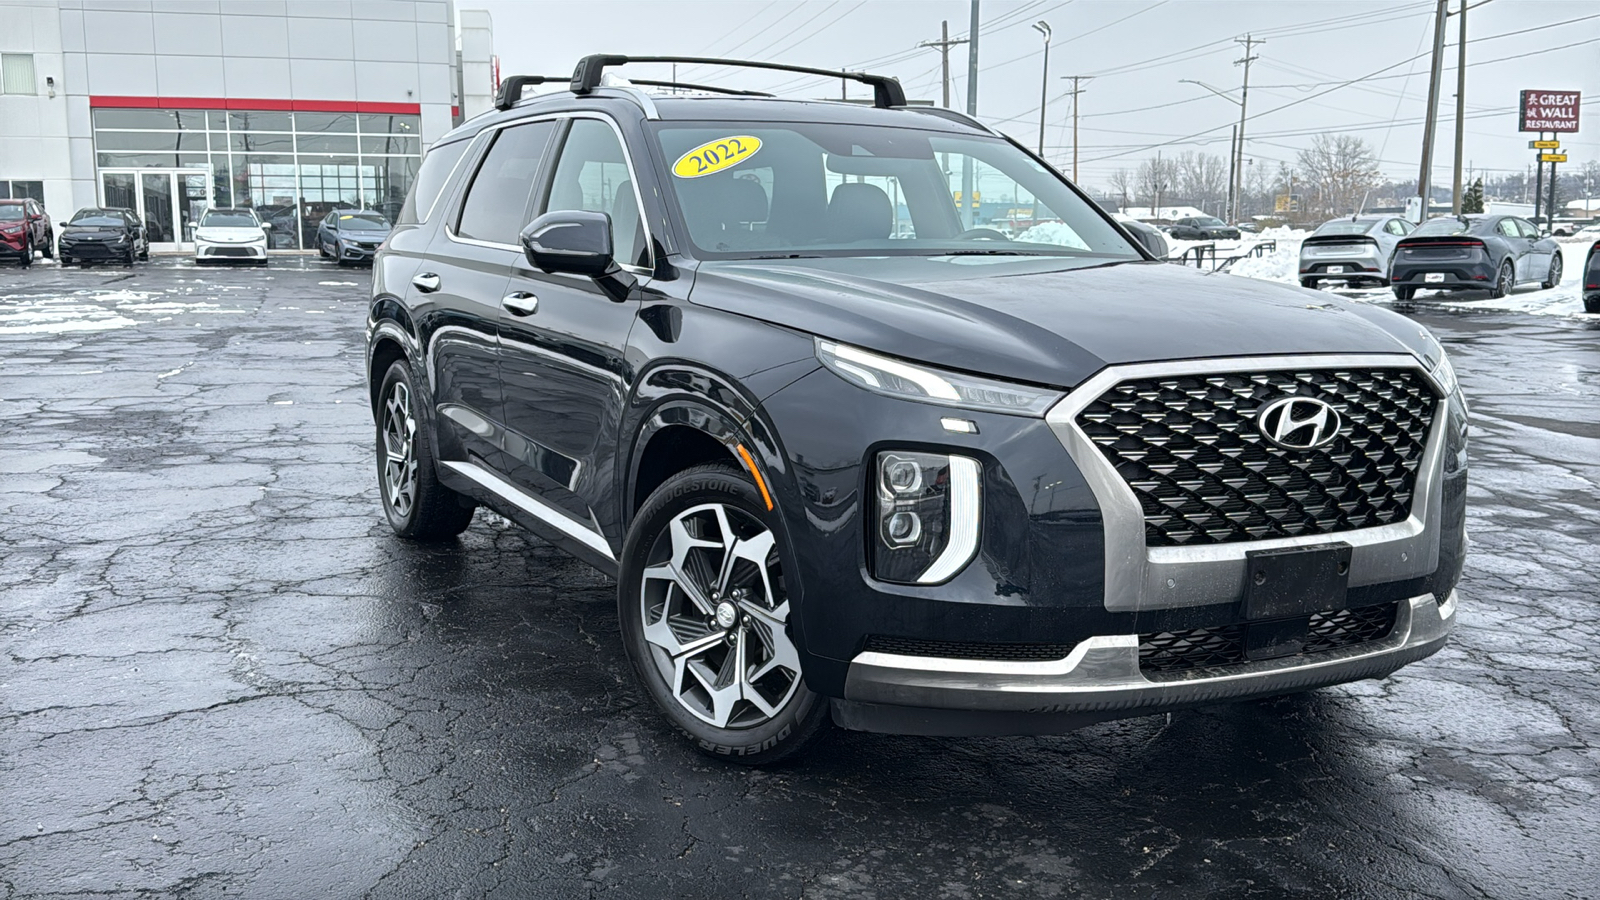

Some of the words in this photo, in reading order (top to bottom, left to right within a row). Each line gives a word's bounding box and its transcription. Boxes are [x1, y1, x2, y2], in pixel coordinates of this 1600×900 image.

[1539, 94, 1578, 106] GREAT
[1539, 107, 1576, 118] WALL
[689, 139, 748, 173] 2022
[698, 723, 792, 756] DUELER
